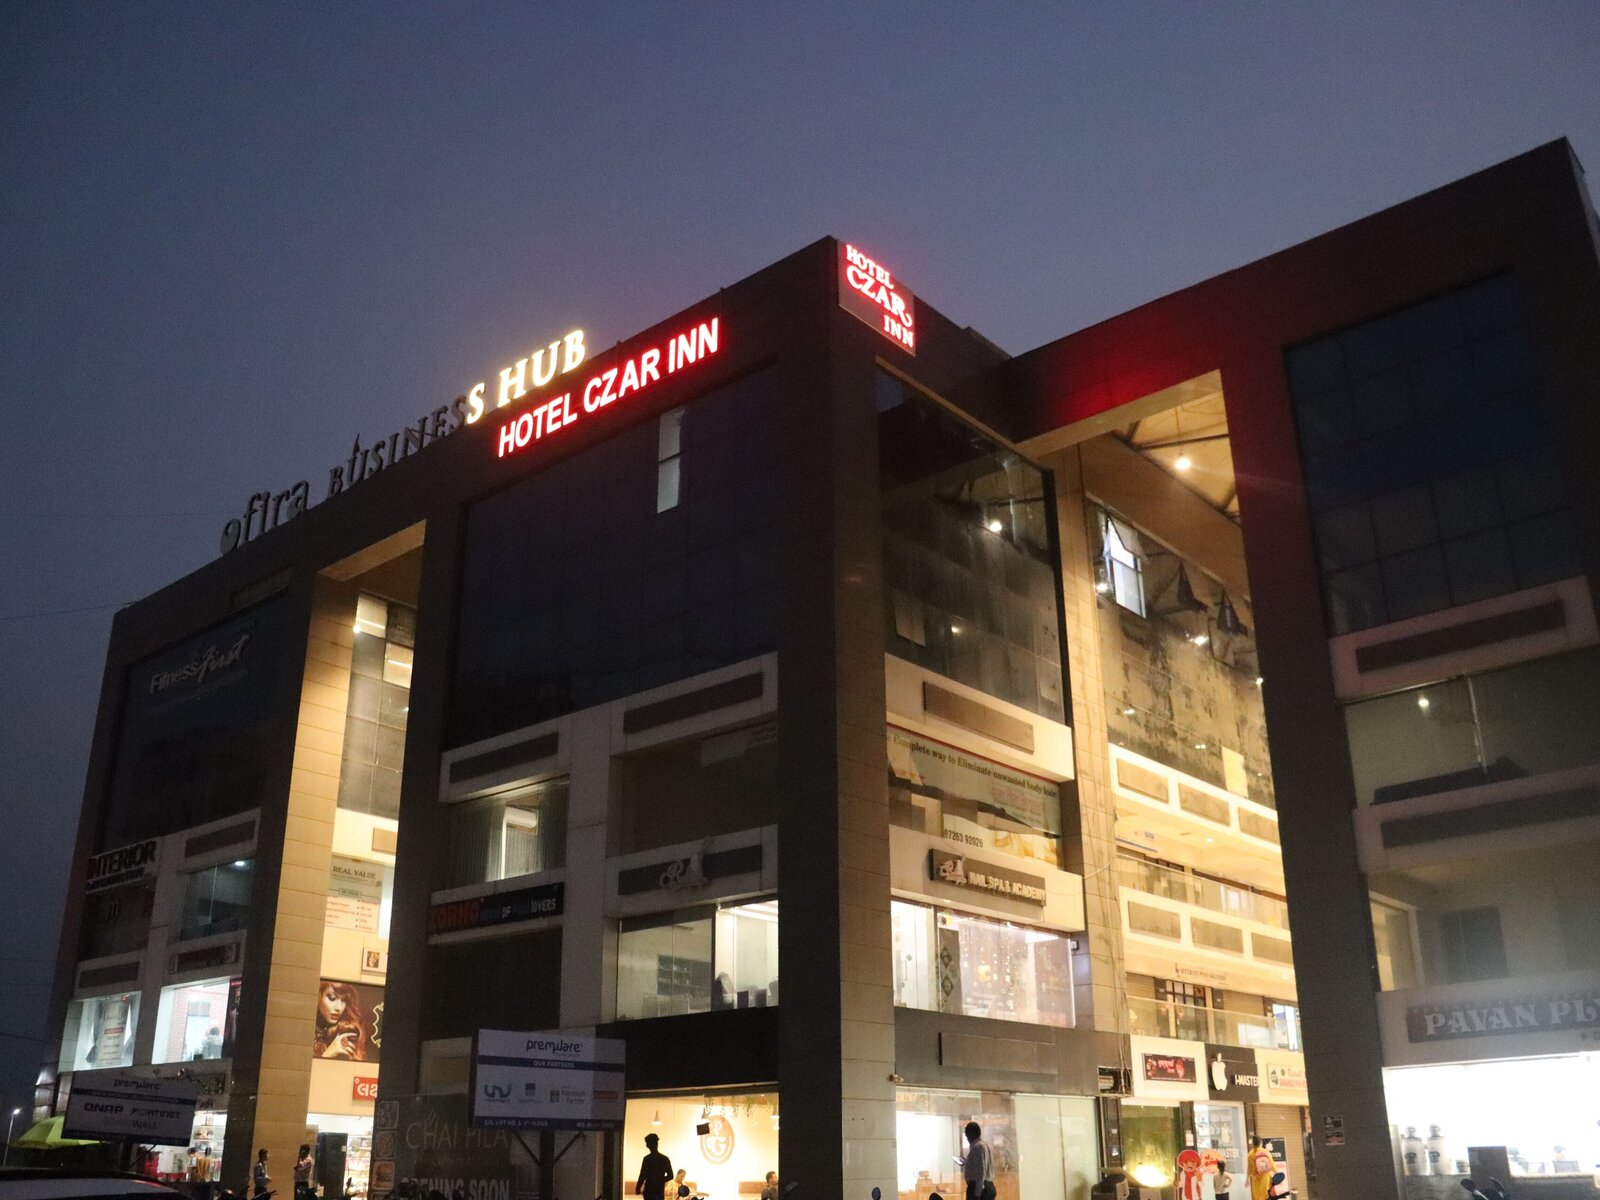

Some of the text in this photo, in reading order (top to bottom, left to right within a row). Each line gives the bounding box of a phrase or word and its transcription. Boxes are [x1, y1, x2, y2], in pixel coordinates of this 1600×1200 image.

[846, 244, 894, 289] HOTEL
[846, 265, 913, 327] CZAR
[884, 314, 914, 348] INN
[498, 317, 719, 458] HOTEL CZAR INN
[328, 382, 486, 497] BUSINESS
[497, 330, 586, 408] HUB
[932, 750, 946, 763] way
[948, 754, 956, 764] to
[957, 757, 992, 776] Eliminate
[993, 771, 1026, 787] unwanted
[1026, 779, 1043, 795] body
[1043, 785, 1057, 798] hair
[332, 865, 352, 876] REAL
[354, 869, 376, 880] VALUE
[1012, 882, 1046, 901] ACADEMY
[1424, 1003, 1538, 1037] PAVAN
[83, 1102, 124, 1114] QNAP
[406, 1118, 457, 1149] CHAI
[400, 1177, 510, 1200] PENING SOON
